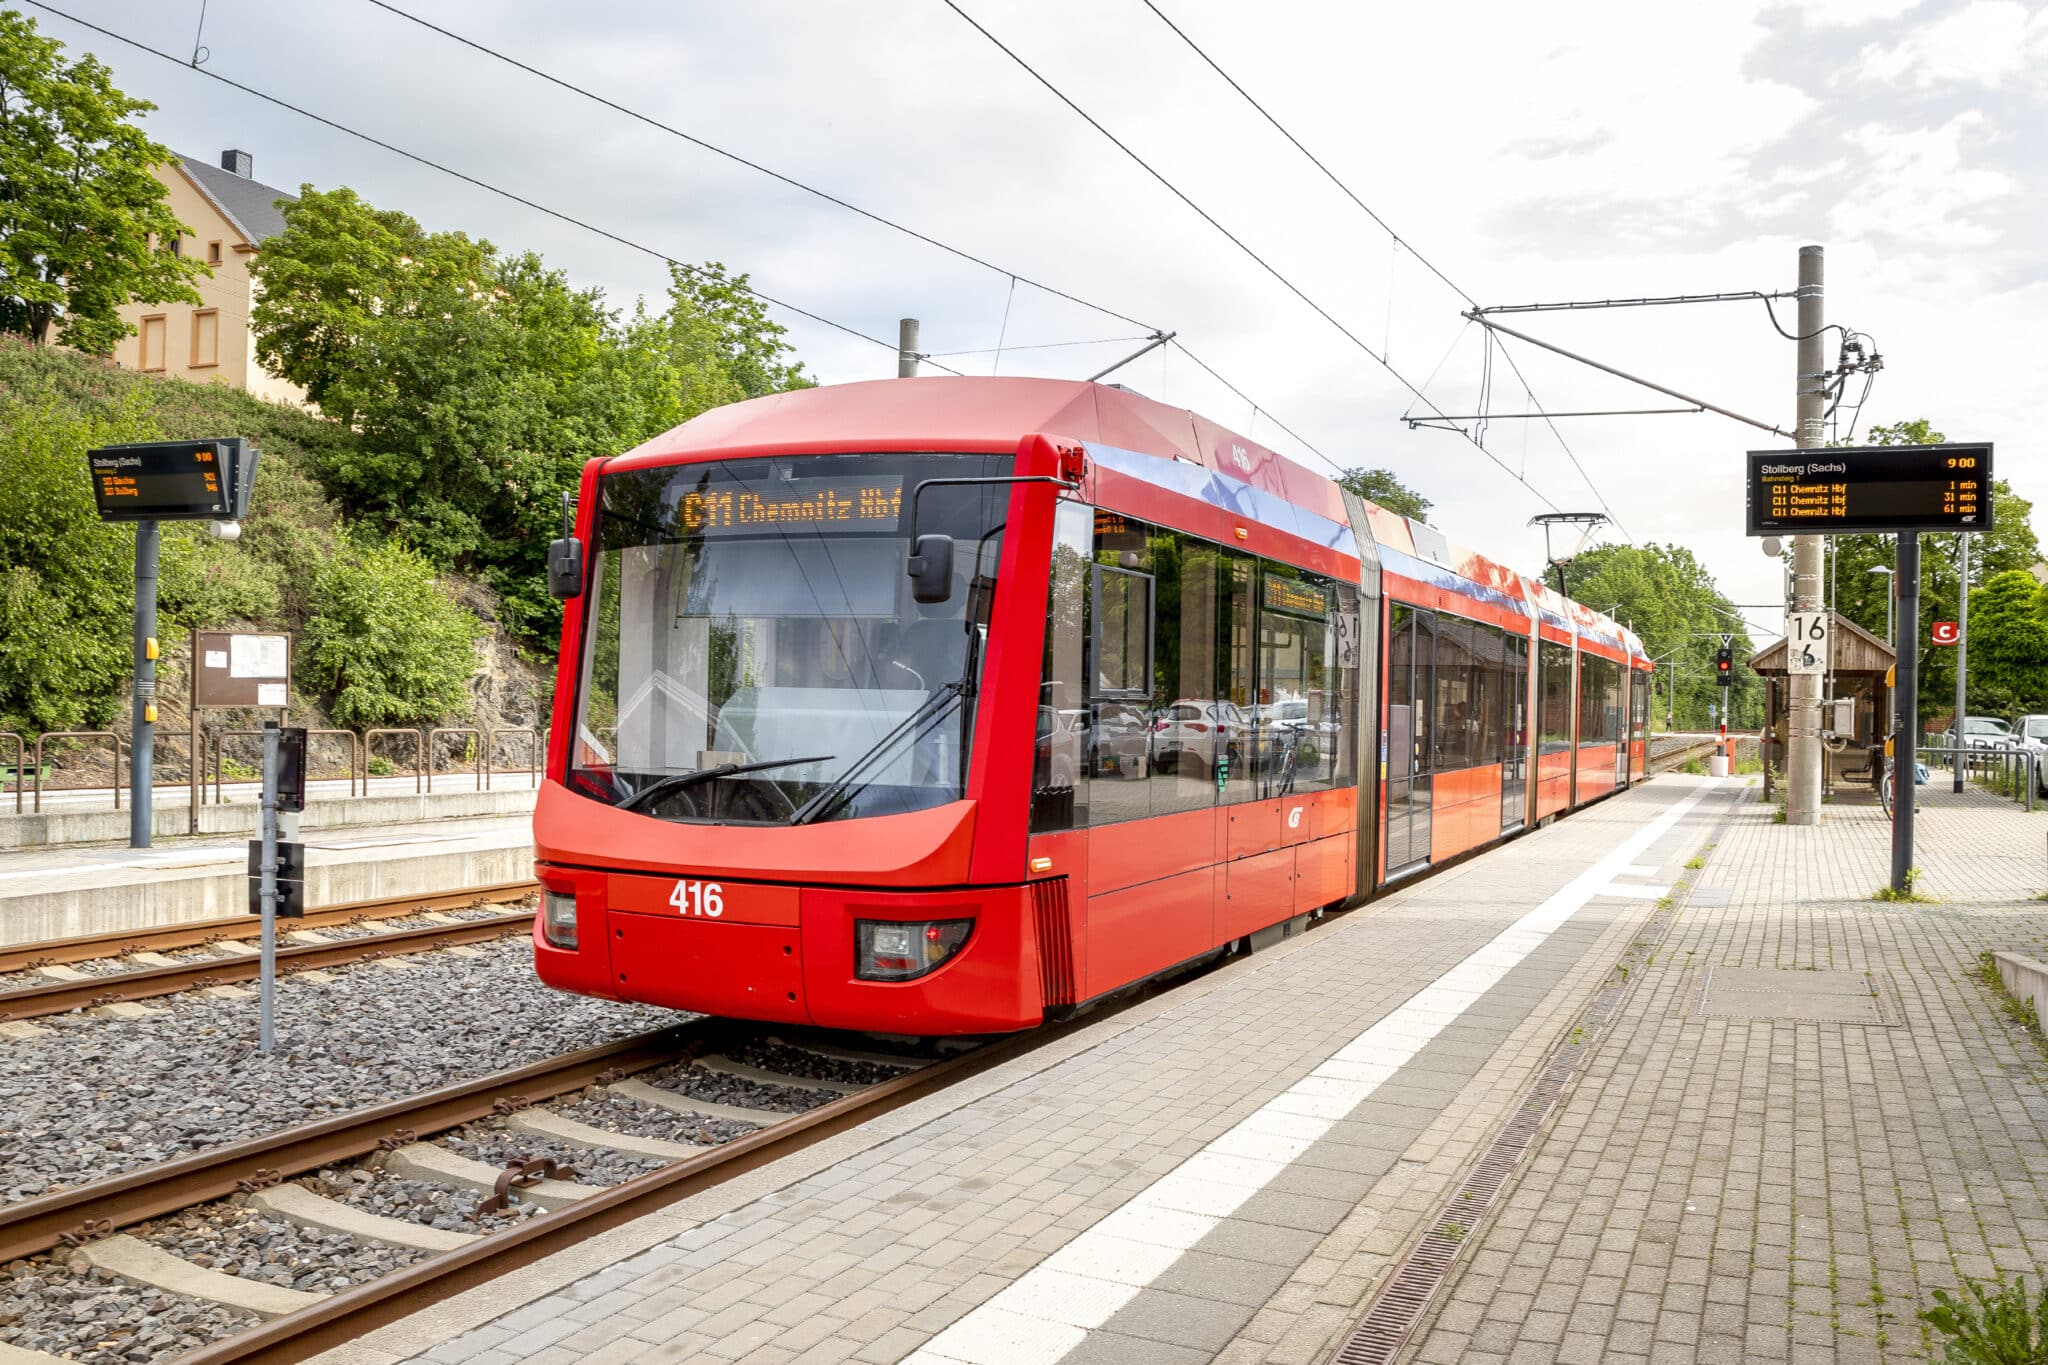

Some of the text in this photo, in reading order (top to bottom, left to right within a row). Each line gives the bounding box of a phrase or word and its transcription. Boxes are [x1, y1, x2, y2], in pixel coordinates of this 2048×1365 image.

[1232, 443, 1251, 471] 416
[1761, 462, 1846, 475] Stollberg (Sachs)
[1772, 480, 1977, 494] C11 Chemnitz Hbf 1 min
[684, 486, 902, 527] C11 Chemnitz Hbf
[1772, 492, 1977, 506] C11 Chemnitz Hbf 31 min
[1772, 503, 1977, 517] C11 Chemnitz Hbf 61 min
[1794, 616, 1825, 641] 16
[1939, 625, 1951, 638] C
[1803, 644, 1815, 667] 6
[669, 879, 724, 918] 416
